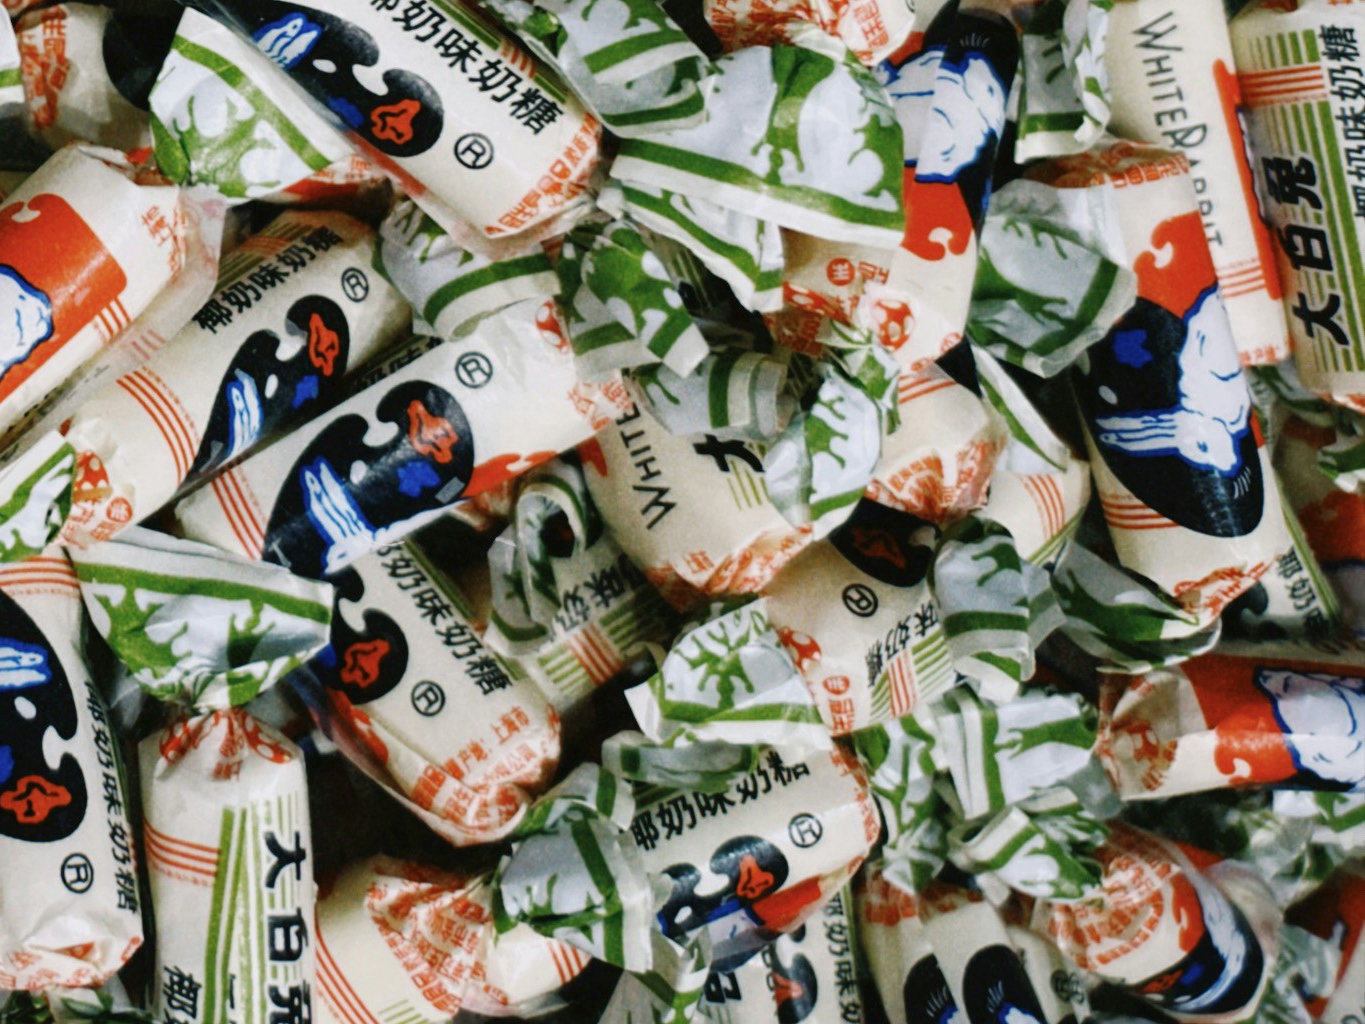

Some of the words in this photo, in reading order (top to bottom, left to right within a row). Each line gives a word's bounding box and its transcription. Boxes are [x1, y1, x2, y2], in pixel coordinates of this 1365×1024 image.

[192, 229, 344, 334] 椰奶味奶糖
[1265, 155, 1350, 349] 大白兔
